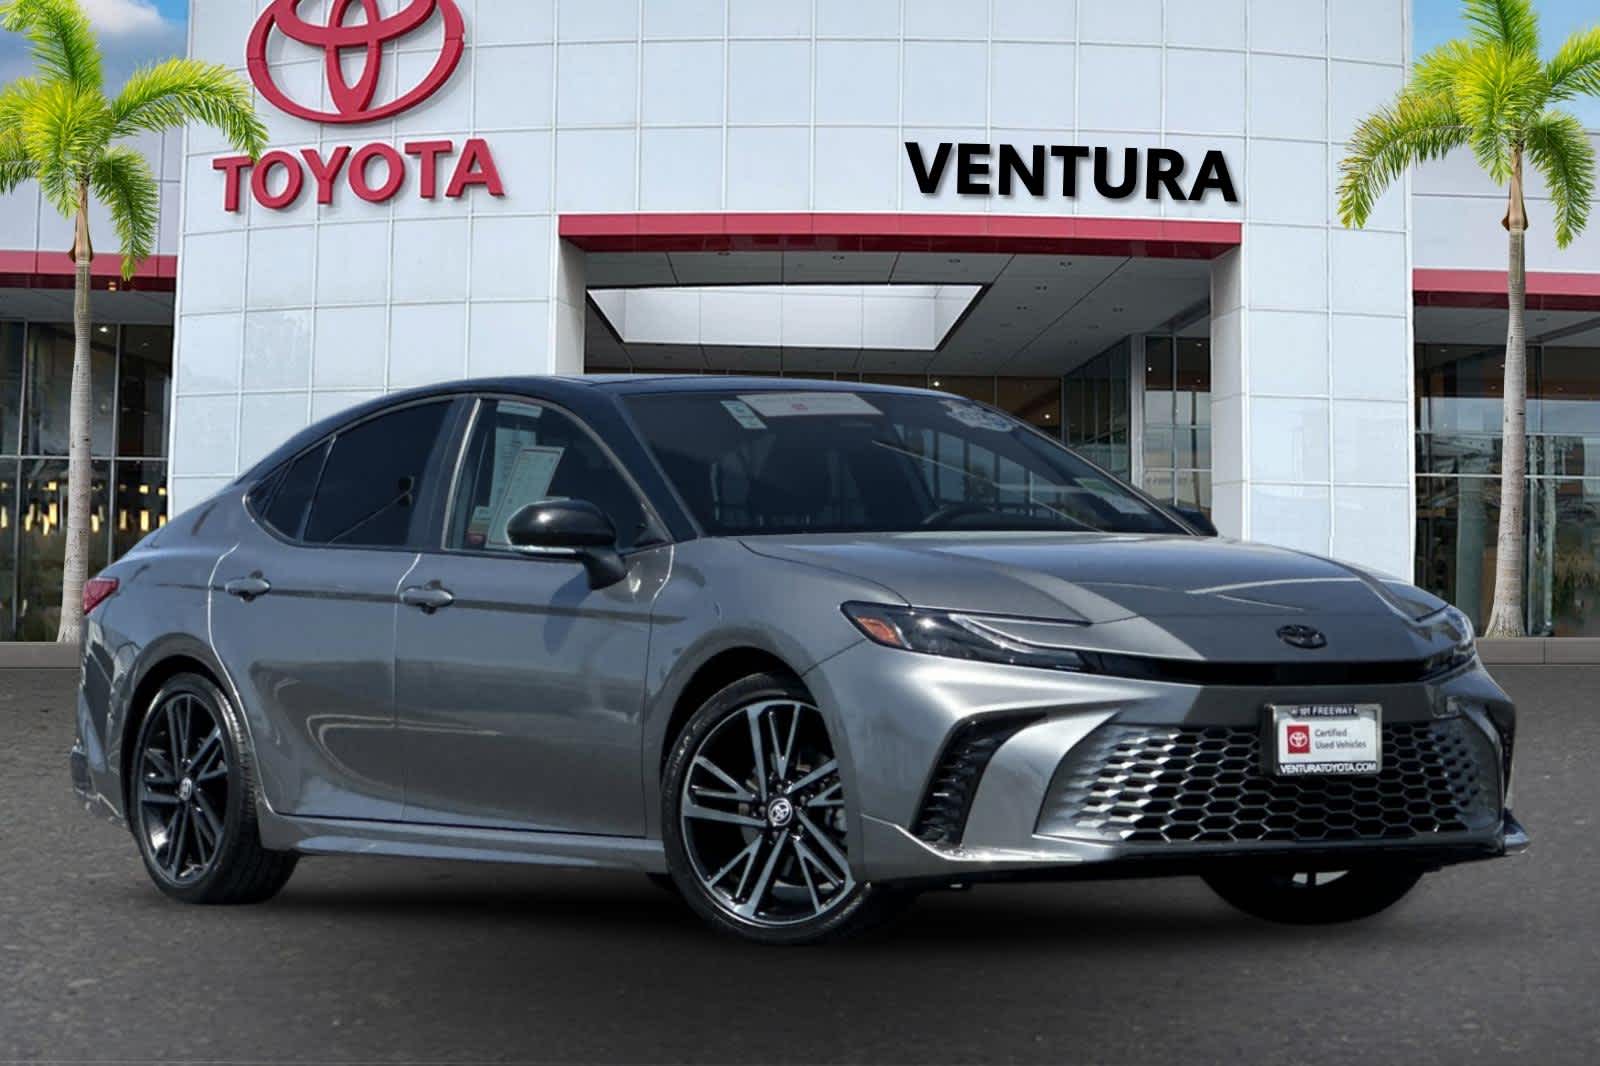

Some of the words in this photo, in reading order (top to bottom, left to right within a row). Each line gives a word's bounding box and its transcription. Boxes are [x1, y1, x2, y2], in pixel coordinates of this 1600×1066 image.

[212, 139, 505, 212] TOYOTA
[904, 142, 1239, 203] VENTURA
[1313, 706, 1353, 716] FREEWAY
[1314, 728, 1347, 737] Certified
[1315, 741, 1334, 749] Used
[1336, 740, 1367, 749] Vehicles
[1280, 762, 1376, 774] VENTURATOYOTA.COM
